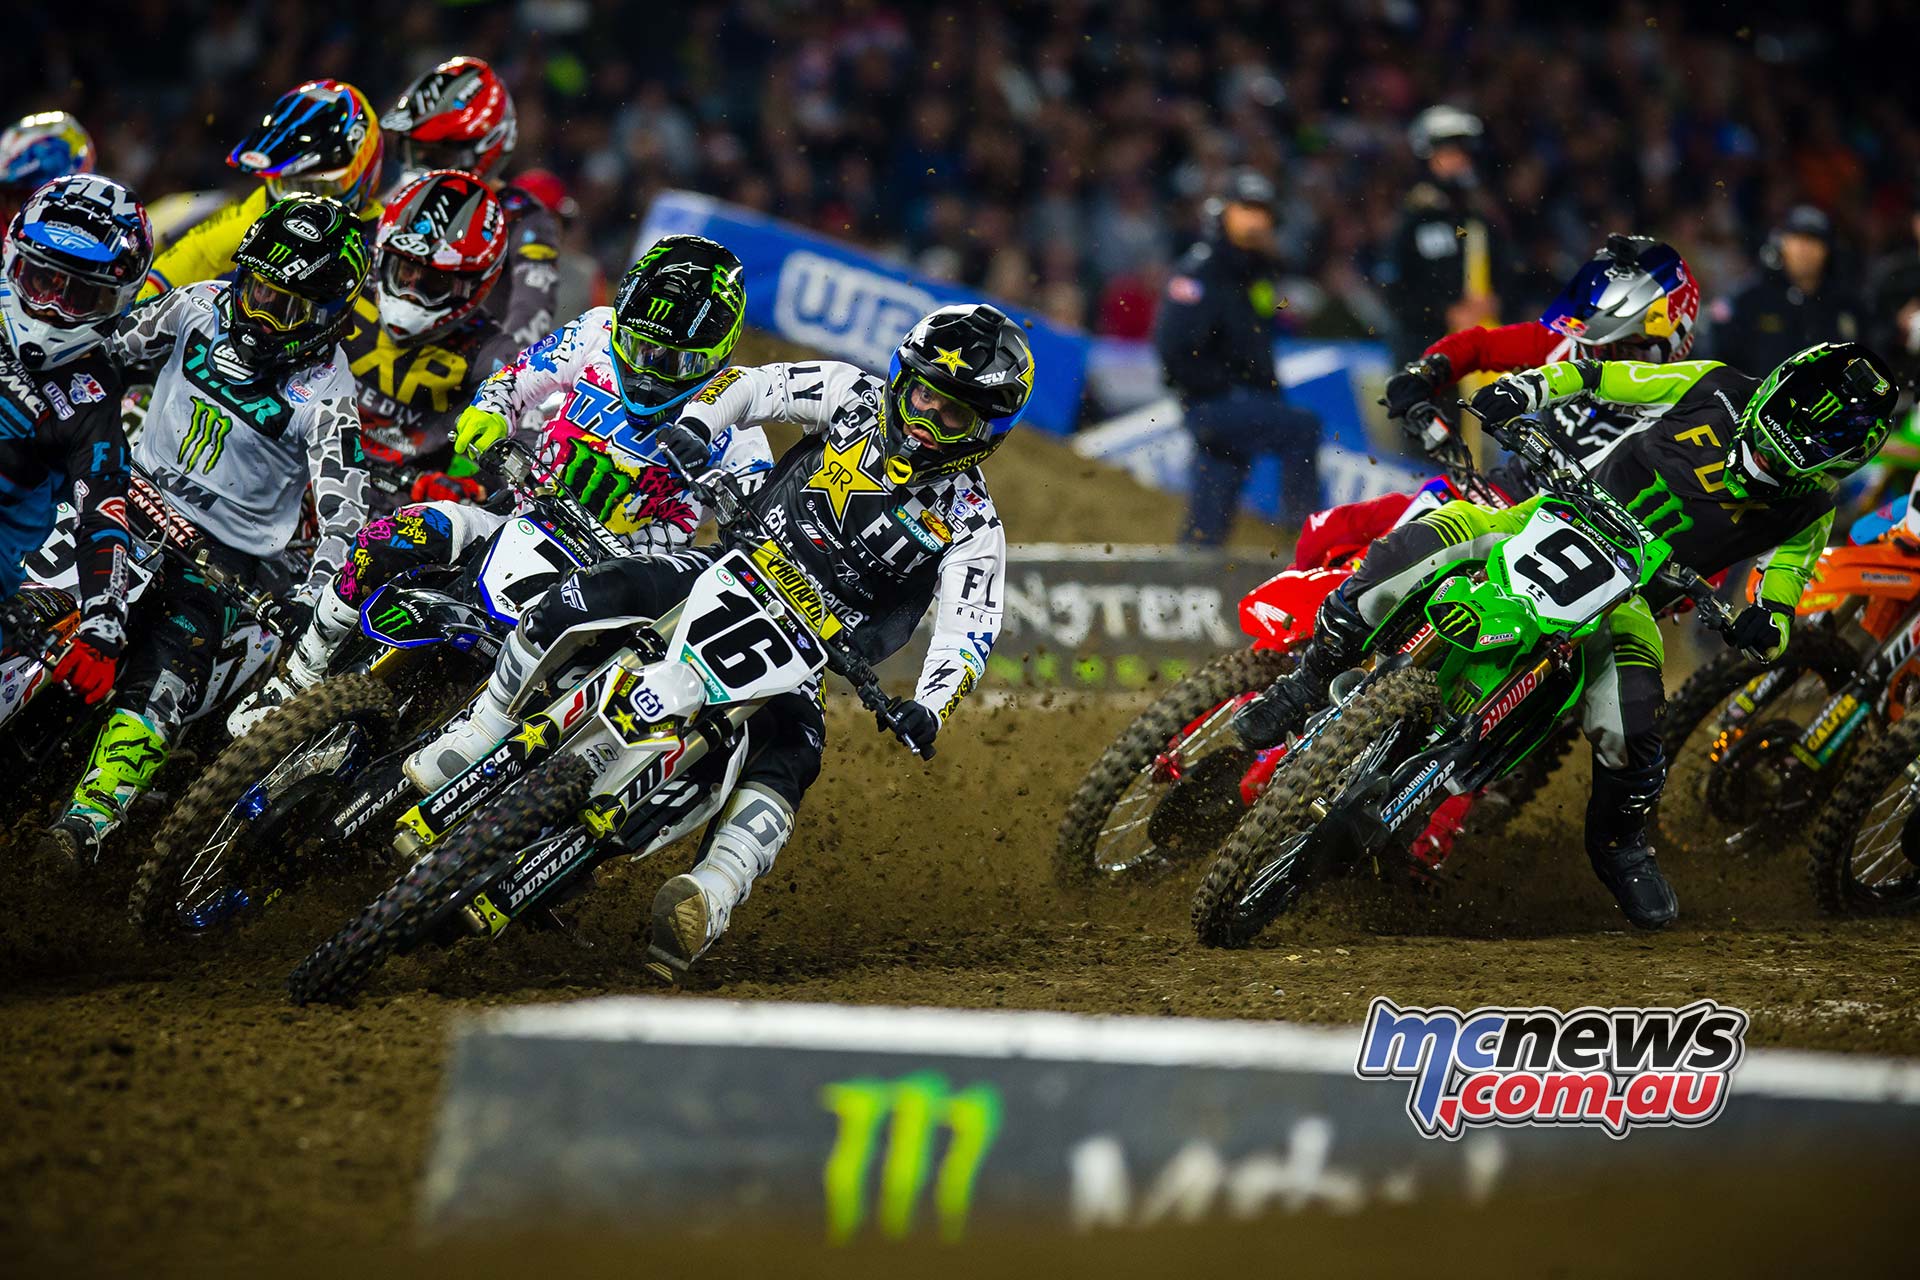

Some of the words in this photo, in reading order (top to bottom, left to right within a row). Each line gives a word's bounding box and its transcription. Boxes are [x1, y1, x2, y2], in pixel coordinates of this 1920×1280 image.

[286, 220, 320, 240] Arai
[238, 253, 290, 284] MONSTER
[626, 317, 673, 337] MONSTER
[787, 365, 825, 402] LY
[1763, 414, 1806, 466] MONSTER
[562, 533, 594, 565] MONSTER
[903, 516, 940, 552] MOTOREX
[1579, 522, 1617, 556] MONSTER
[1513, 527, 1616, 608] 9
[767, 554, 826, 631] PROTAPER
[1003, 570, 1240, 650] NSTER
[686, 589, 794, 690] 16
[1480, 670, 1538, 742] SHOWA
[1388, 760, 1456, 833] DUNLOP
[1399, 759, 1440, 802] CARRILLO
[333, 792, 371, 827] BRAKING
[343, 776, 412, 840] DUNLO
[510, 834, 587, 909] DUNLOP
